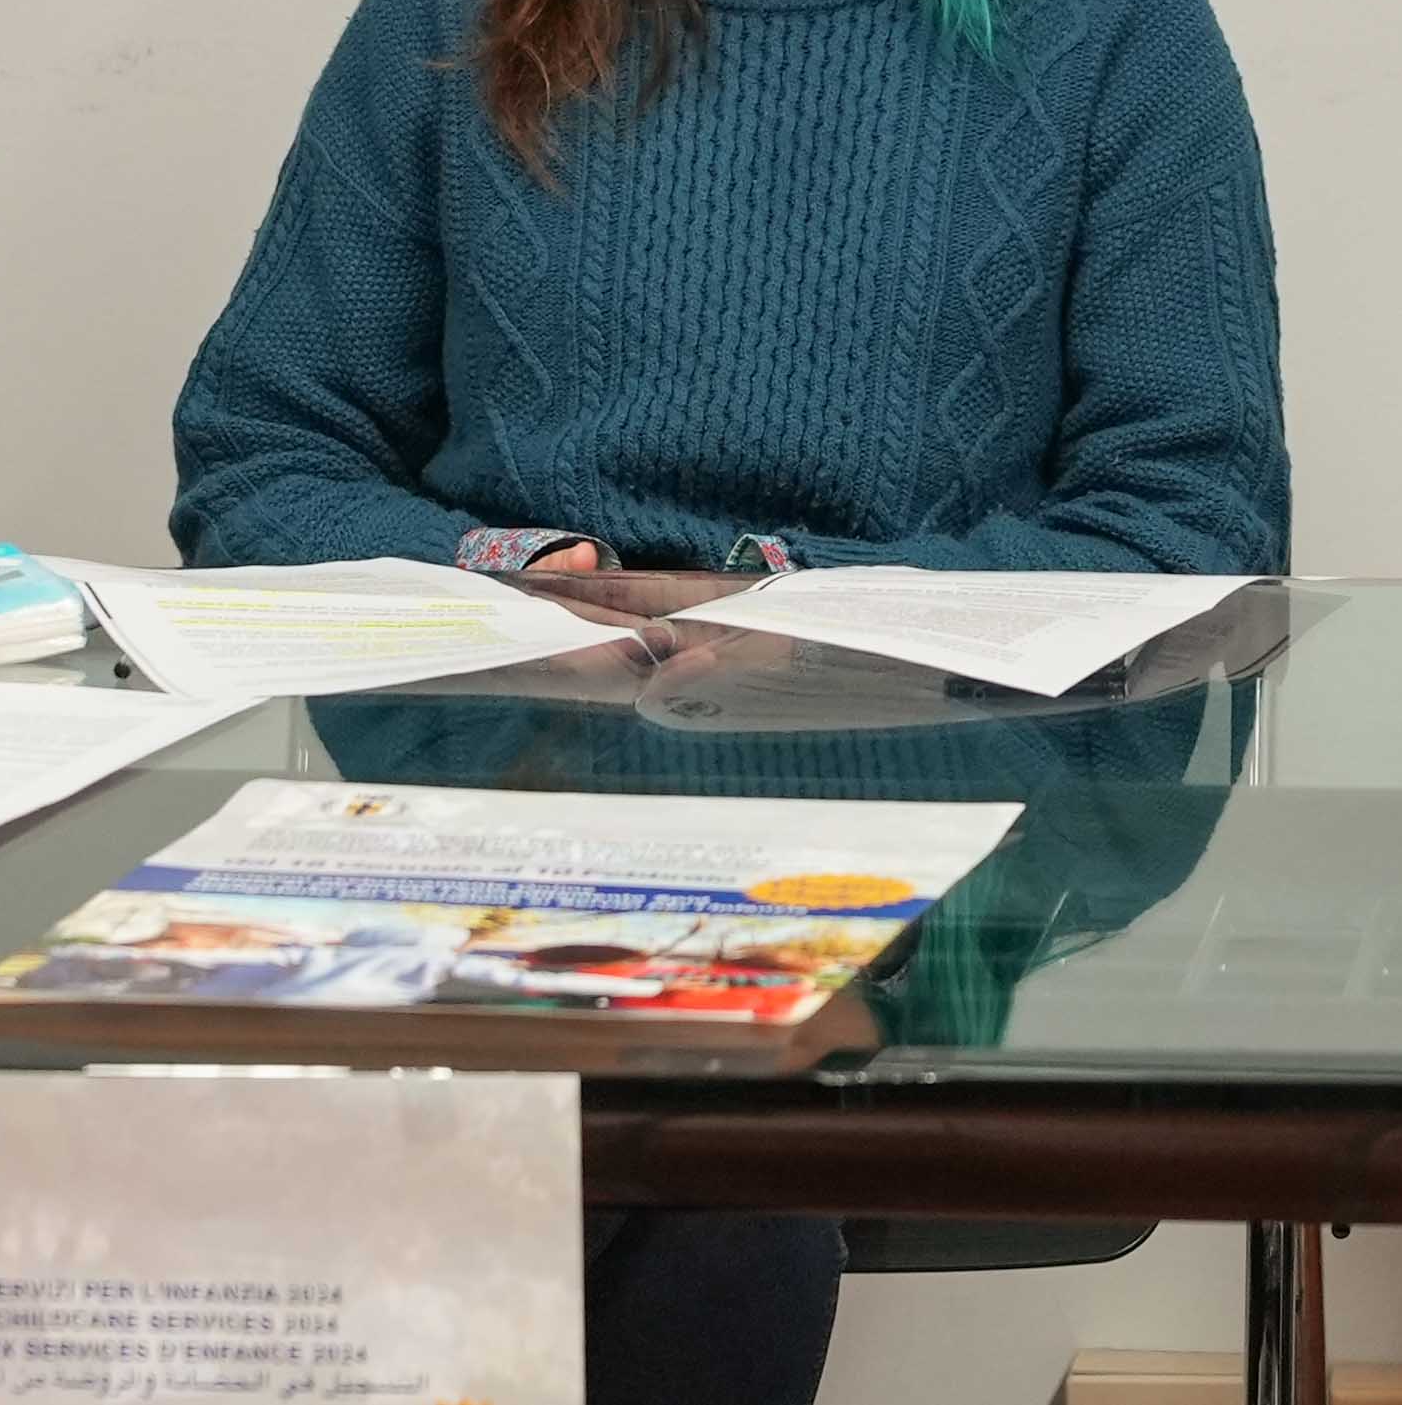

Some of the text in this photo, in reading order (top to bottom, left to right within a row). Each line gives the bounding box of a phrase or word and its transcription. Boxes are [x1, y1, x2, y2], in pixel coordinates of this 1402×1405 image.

[85, 1281, 134, 1301] PER
[288, 1283, 343, 1304] 2024
[150, 1313, 275, 1333] SERVICES
[284, 1315, 339, 1334] 2024
[25, 1341, 148, 1361] SERVICES
[313, 1346, 368, 1366] 2024
